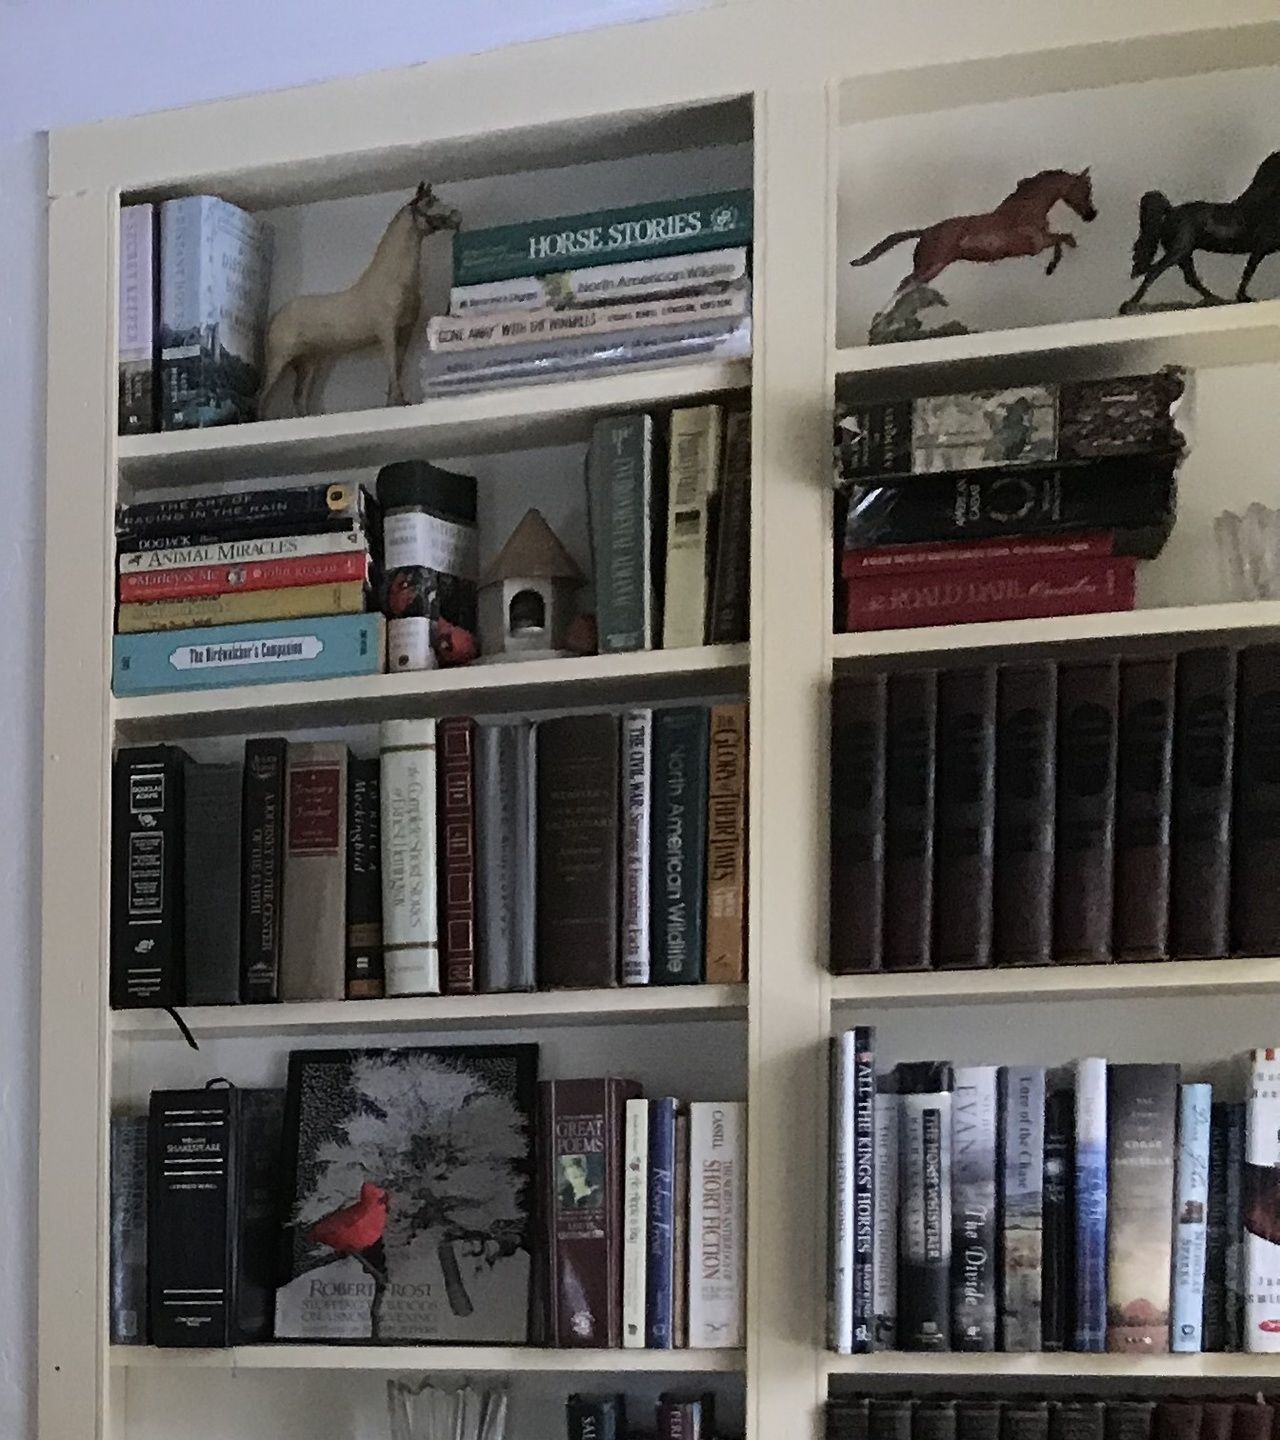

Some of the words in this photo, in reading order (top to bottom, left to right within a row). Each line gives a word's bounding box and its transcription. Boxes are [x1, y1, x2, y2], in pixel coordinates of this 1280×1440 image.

[528, 227, 604, 259] HORSE
[608, 211, 702, 247] STORIES
[148, 550, 214, 568] ANIMAL
[217, 540, 298, 562] MIRACLES
[190, 649, 203, 663] The
[630, 725, 645, 749] THE
[631, 751, 644, 779] CIVIL
[667, 745, 684, 798] North
[630, 780, 644, 807] WAR
[351, 781, 366, 874] Mockingbird
[666, 803, 684, 900] American
[666, 902, 686, 974] Wildlife
[857, 1064, 873, 1096] ALL
[556, 1120, 604, 1137] GREAT
[857, 1098, 872, 1132] THE
[926, 1115, 939, 1140] THE
[557, 1138, 604, 1153] POEMS
[1020, 1126, 1033, 1147] the
[926, 1143, 939, 1184] HORSE
[702, 1159, 721, 1211] SHORT
[856, 1192, 871, 1253] HORSES
[926, 1186, 939, 1258] WHISPERER
[965, 1204, 987, 1240] The
[701, 1216, 721, 1280] FICTION
[309, 1279, 374, 1298] ROBERT
[965, 1246, 988, 1306] Divide
